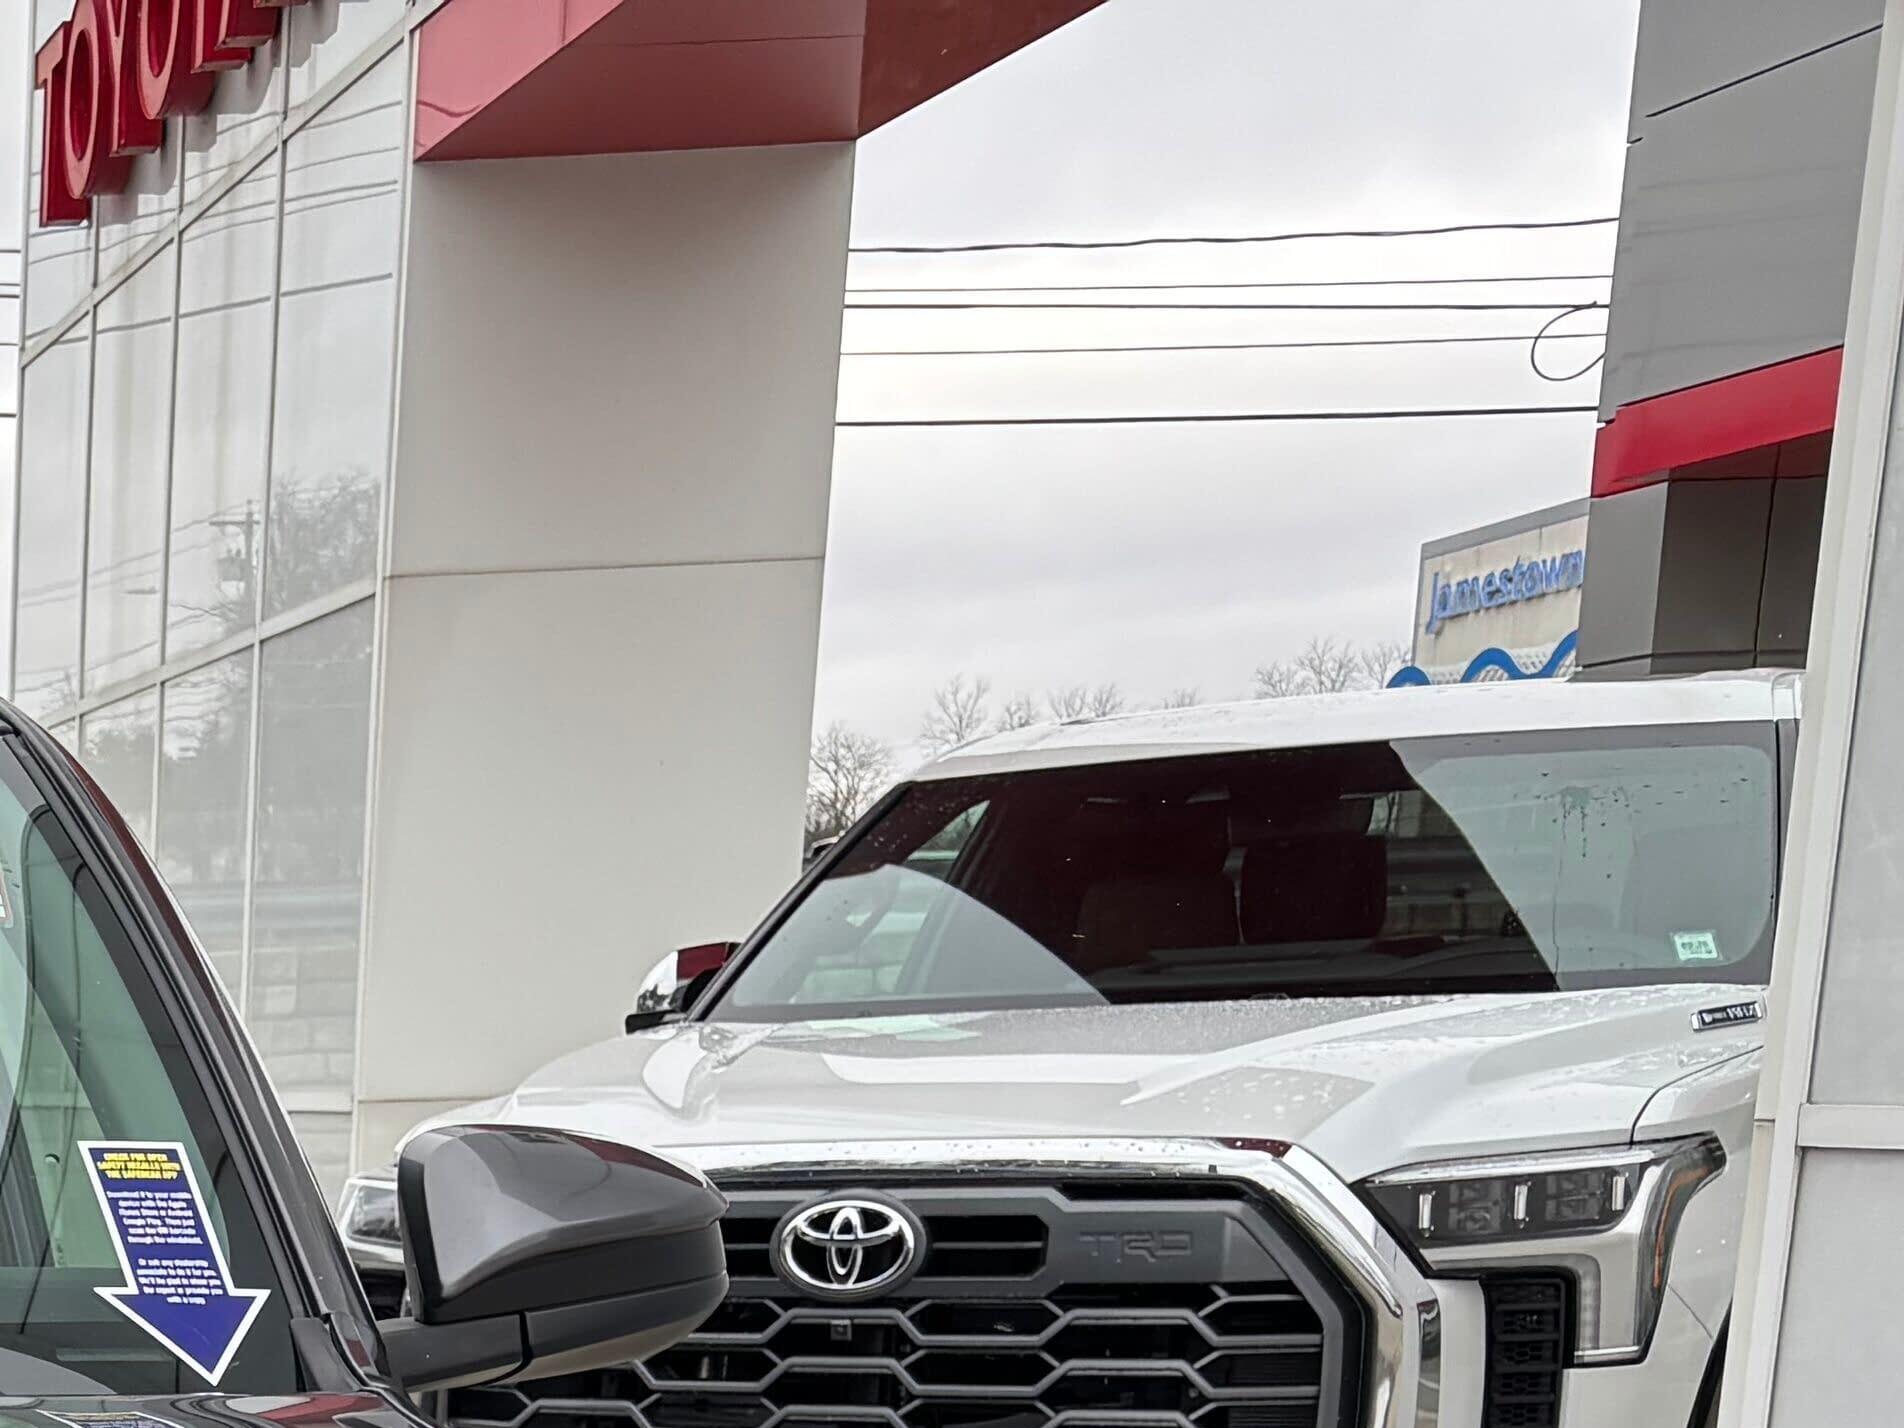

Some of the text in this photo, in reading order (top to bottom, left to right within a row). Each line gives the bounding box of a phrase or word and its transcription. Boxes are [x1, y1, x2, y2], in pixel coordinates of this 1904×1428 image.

[35, 0, 309, 228] TOYO
[1425, 551, 1583, 635] Jamestown
[1078, 1231, 1192, 1264] TRD
